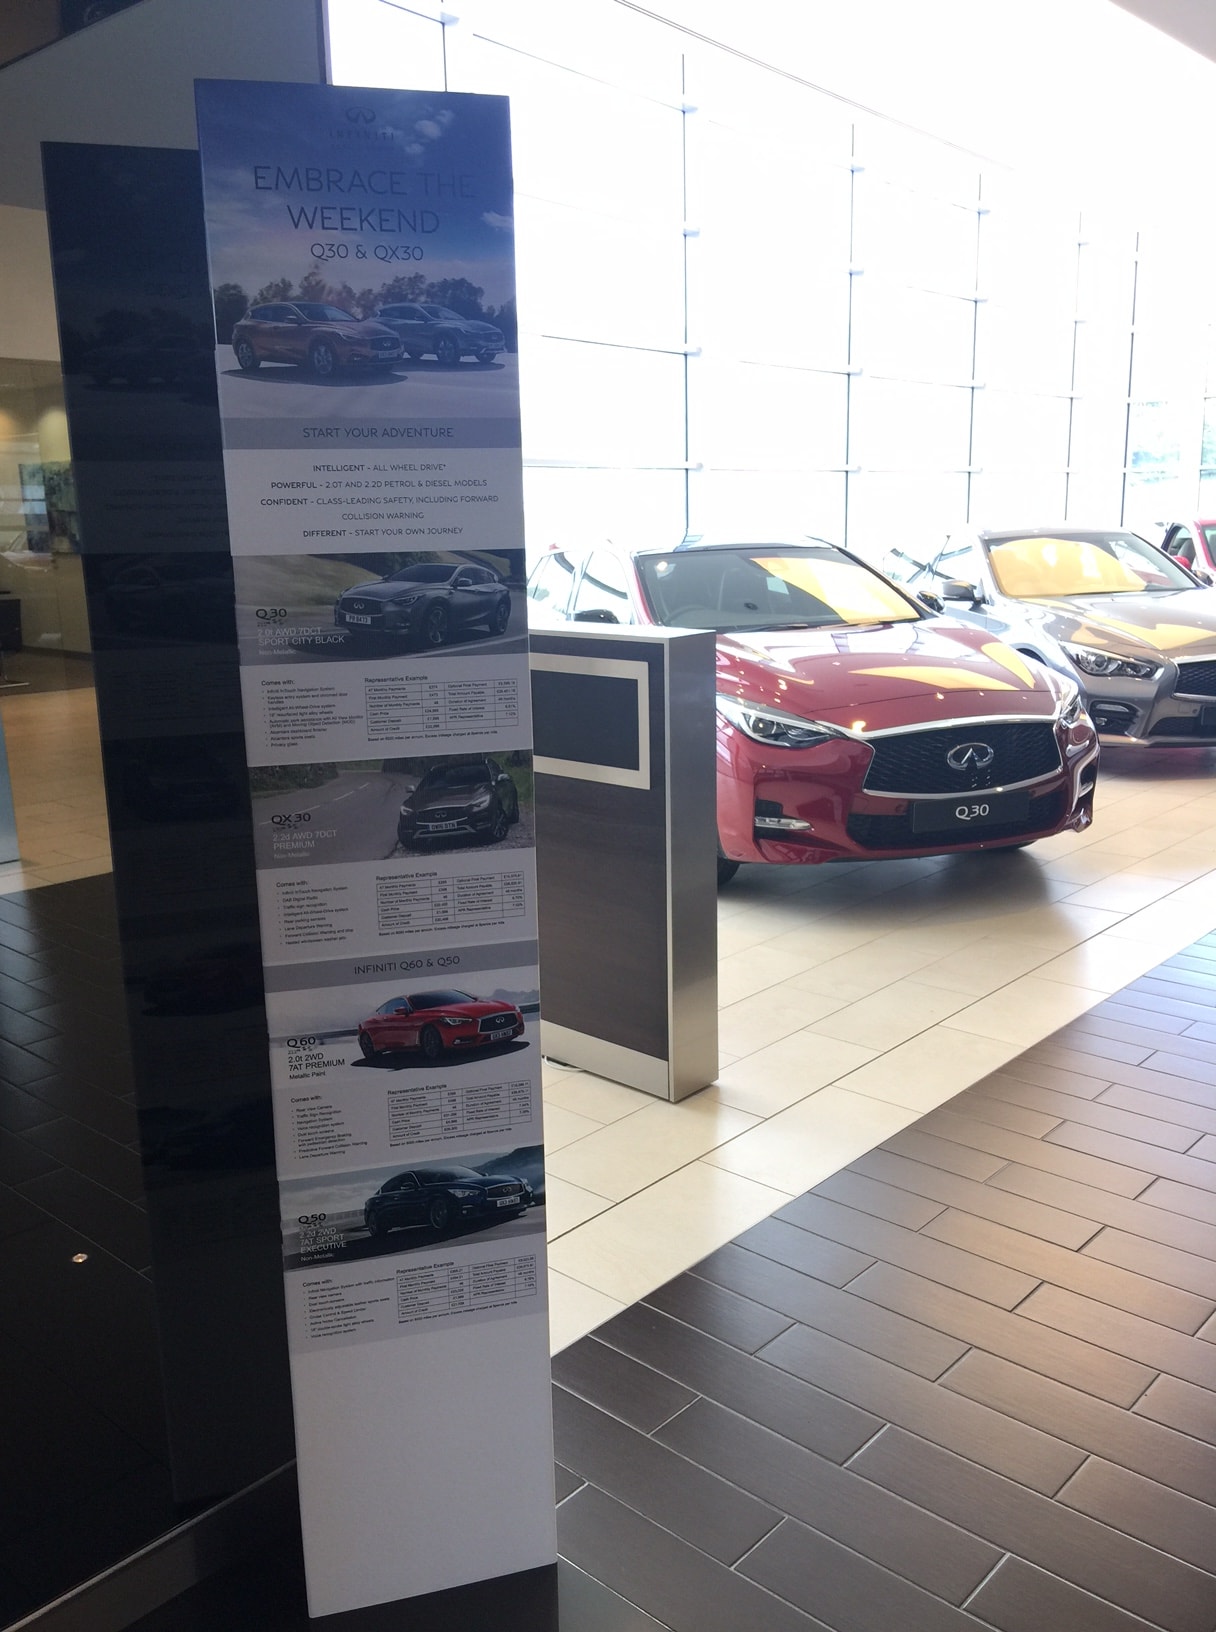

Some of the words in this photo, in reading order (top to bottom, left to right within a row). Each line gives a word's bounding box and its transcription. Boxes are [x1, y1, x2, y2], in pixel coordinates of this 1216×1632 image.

[254, 165, 408, 196] EMBRACE
[416, 172, 477, 198] THE
[287, 204, 440, 234] WEEKEND
[310, 243, 349, 262] Q30
[355, 244, 368, 259] &
[374, 244, 424, 264] QX30
[303, 428, 341, 438] START
[344, 428, 378, 438] YOUR
[382, 427, 454, 438] ADVENTURE
[313, 464, 365, 472] INTELLIGENT
[372, 464, 388, 472] ALL
[390, 464, 418, 472] WHEEL
[364, 480, 382, 488] 2.2D
[384, 480, 416, 488] PETROL
[418, 480, 423, 488] &
[425, 480, 452, 488] DIESEL
[260, 498, 308, 506] CONFIDENT
[316, 497, 382, 505] CLASS-LEADING
[416, 496, 458, 504] INCLUDING
[386, 512, 424, 520] WARNING
[303, 530, 346, 538] DIFFERENT
[354, 528, 380, 536] START
[382, 528, 403, 536] YOUR
[256, 608, 288, 620] Q30
[274, 627, 296, 637] AWD
[258, 637, 290, 647] SPORT
[292, 636, 313, 646] CITY
[315, 636, 345, 644] BLACK
[955, 804, 990, 820] Q30
[272, 813, 311, 826] QX30
[292, 832, 312, 840] AWD
[274, 840, 315, 850] PREMIUM
[354, 962, 397, 974] INFINITI
[400, 960, 423, 972] Q60
[426, 959, 433, 967] &
[438, 956, 460, 968] Q50
[287, 1036, 316, 1048] Q60
[288, 1056, 302, 1064] 2.0t
[304, 1052, 324, 1062] 2WD
[289, 1064, 303, 1072] 7AT
[306, 1058, 345, 1070] PREMIUM
[298, 1212, 326, 1224] Q50
[316, 1234, 344, 1244] SPORT
[300, 1240, 347, 1254] EXECUTIVE
